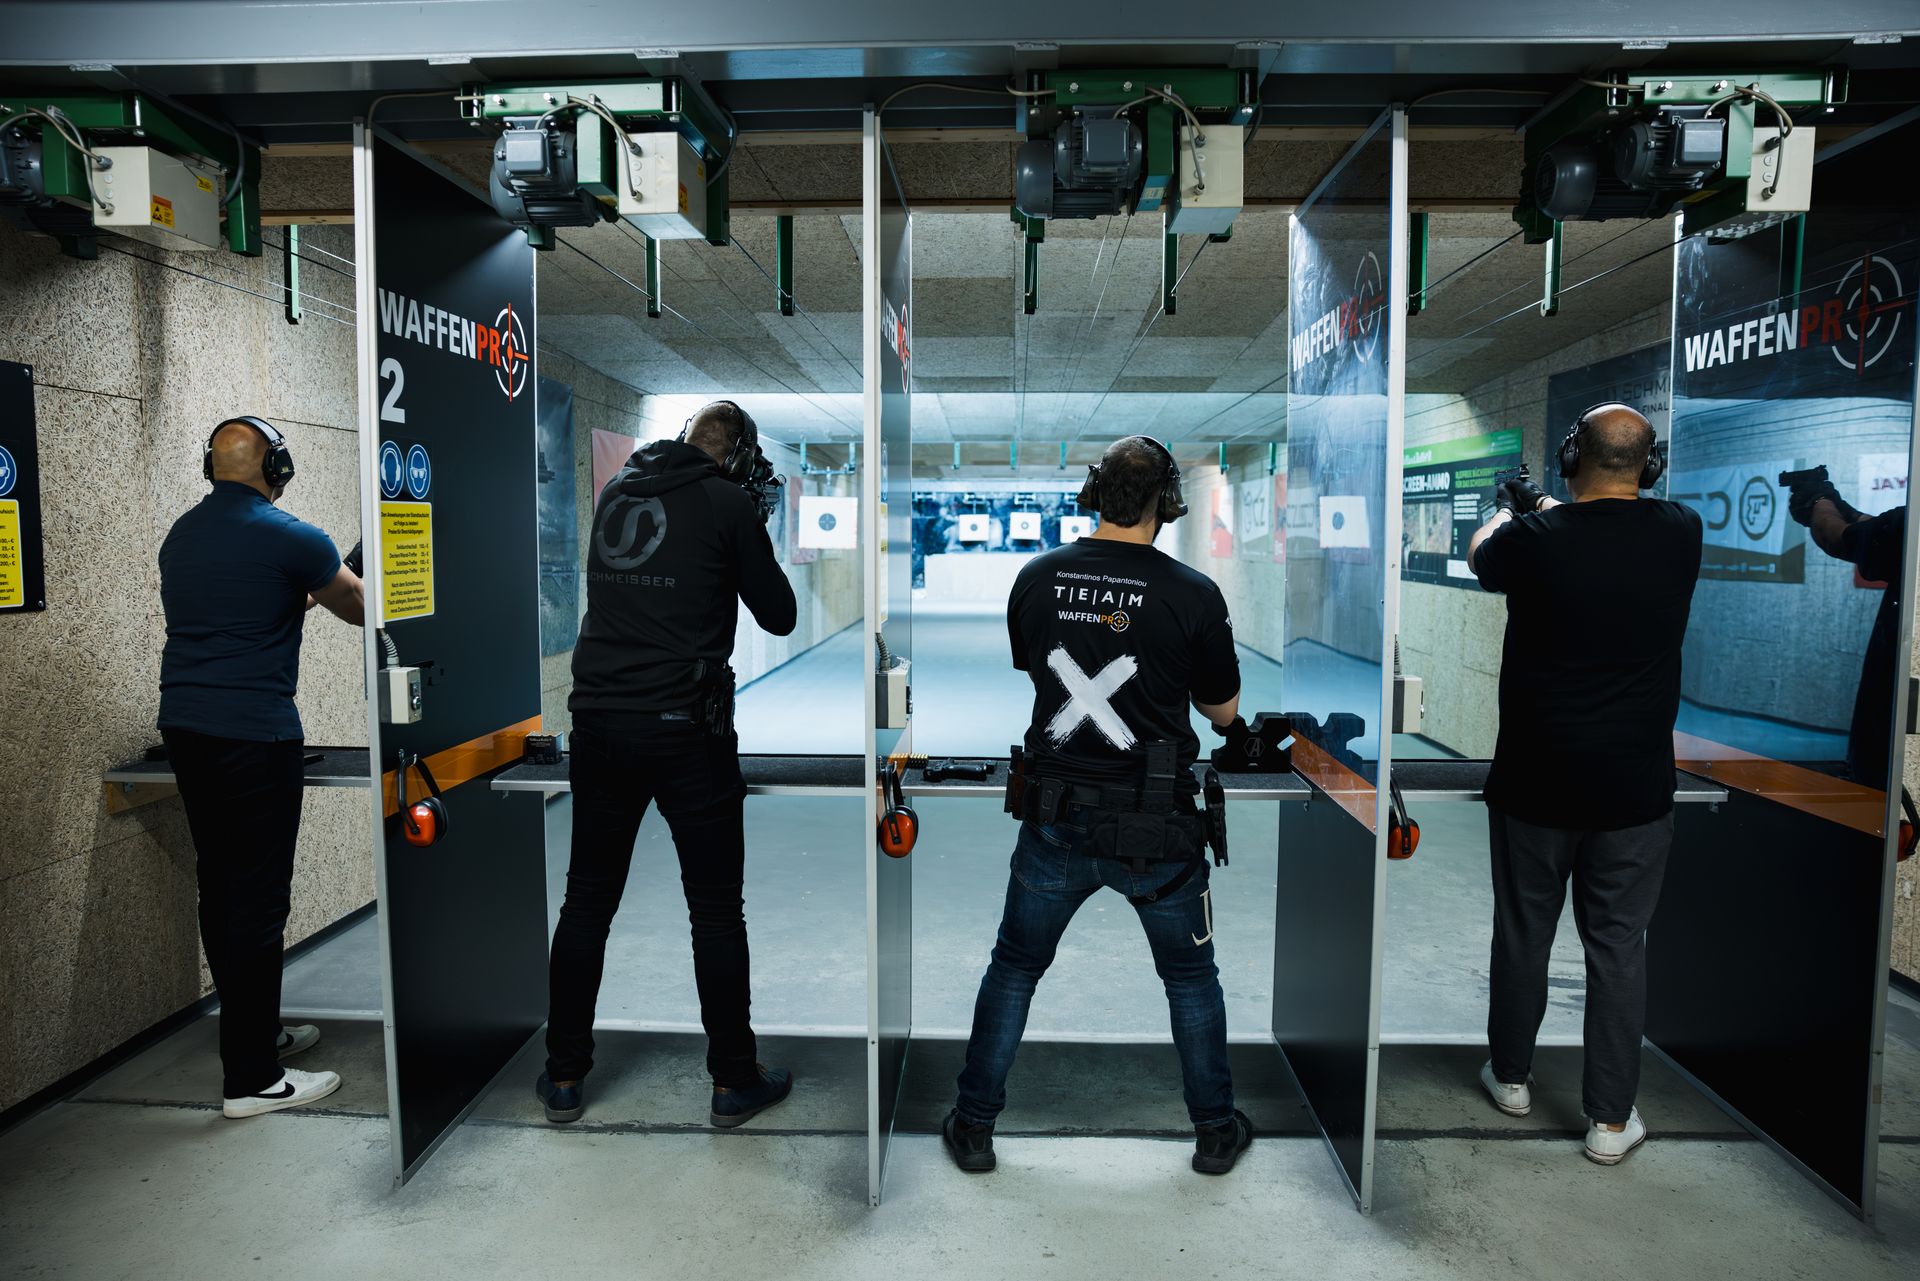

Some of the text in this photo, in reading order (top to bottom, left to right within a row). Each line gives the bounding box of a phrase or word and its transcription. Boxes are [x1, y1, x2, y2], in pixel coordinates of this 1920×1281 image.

[380, 357, 406, 424] 2
[1623, 375, 1671, 401] SCHM
[1056, 571, 1148, 588] Konstantinos Papantoniou
